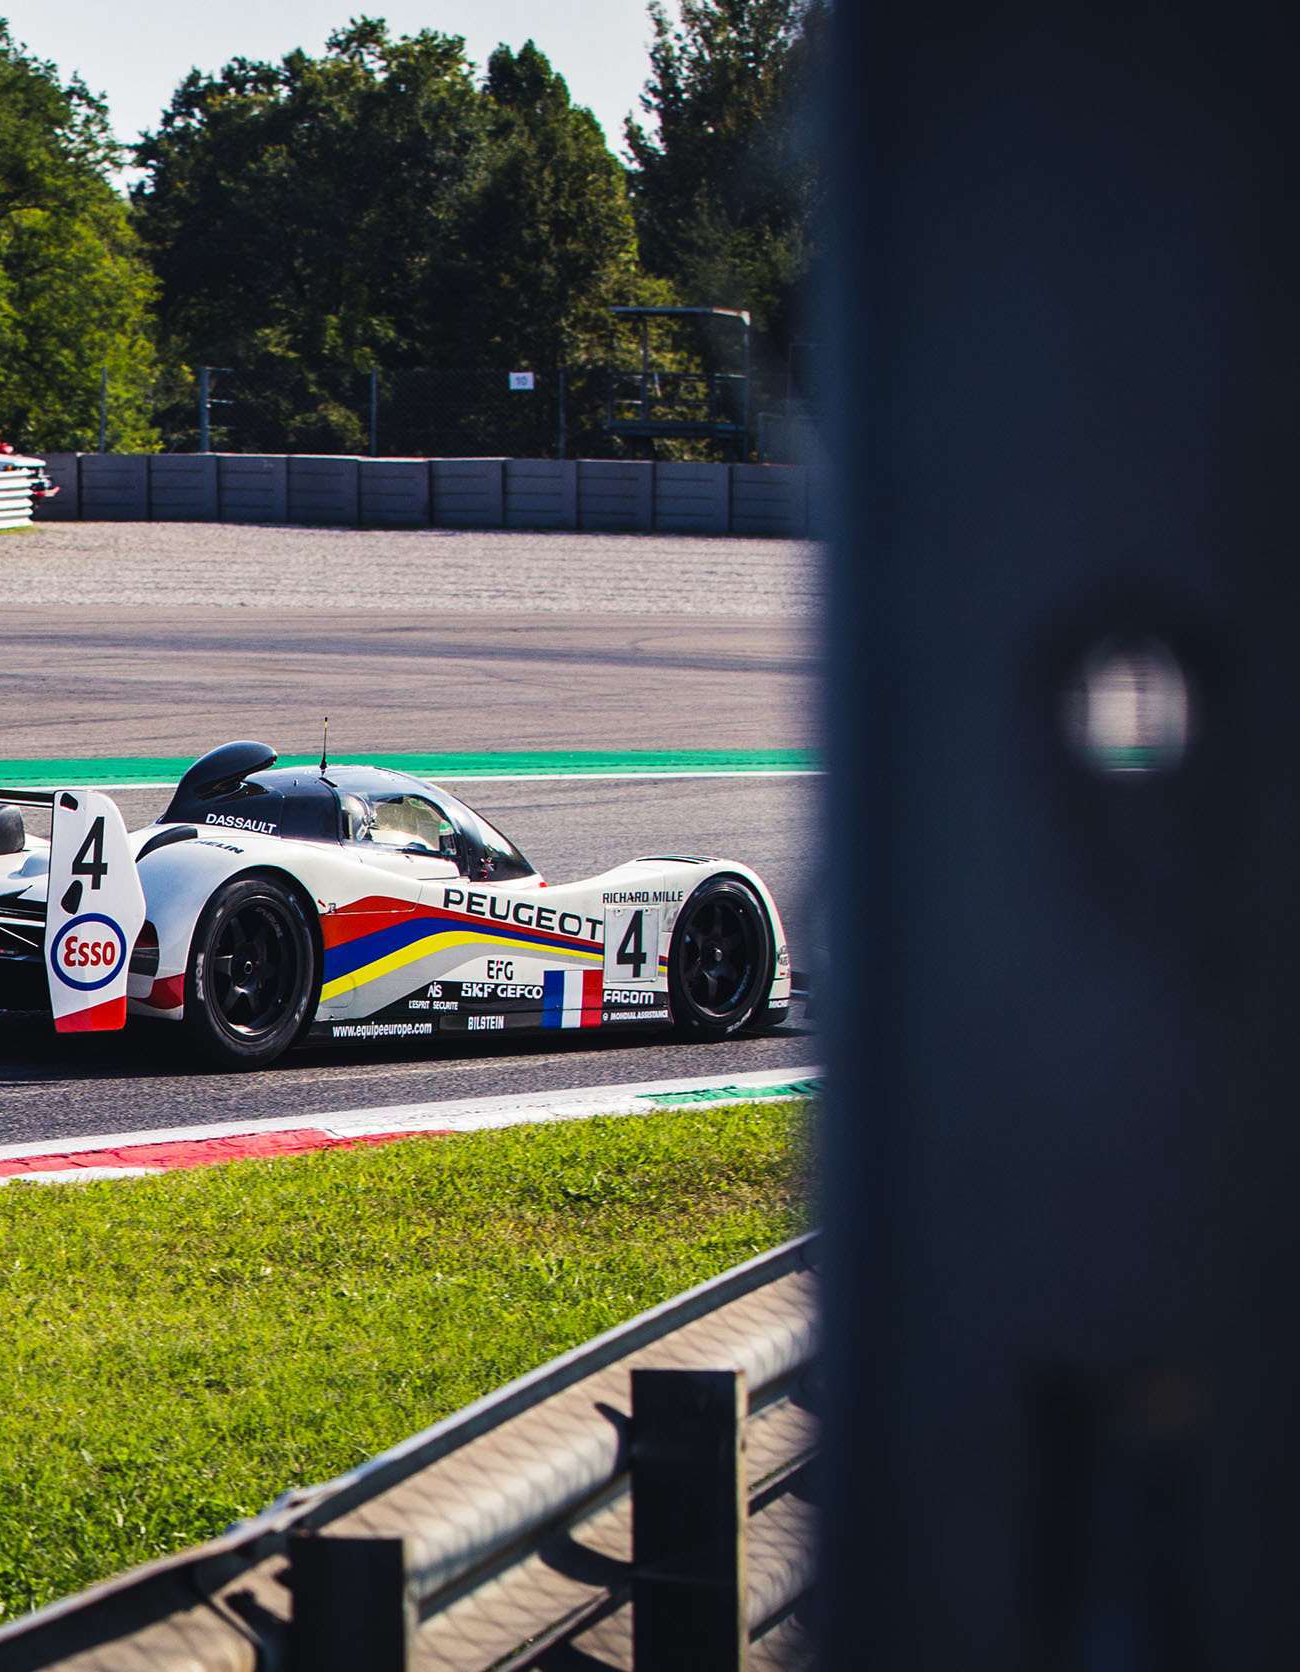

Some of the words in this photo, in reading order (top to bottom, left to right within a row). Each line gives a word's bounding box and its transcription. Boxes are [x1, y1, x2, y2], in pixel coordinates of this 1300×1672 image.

[205, 813, 277, 834] DASSAULT
[71, 816, 108, 890] 4
[602, 891, 650, 904] RICHARD
[652, 890, 684, 903] MILLE
[443, 888, 604, 940] PEUGEOT
[616, 909, 647, 978] 4
[487, 959, 514, 981] EFG
[460, 982, 494, 999] SKF
[497, 984, 544, 1000] GEFCO
[603, 990, 654, 1005] FACOM
[332, 1021, 432, 1039] www.equipeeurope.com
[467, 1016, 505, 1031] BILSTEIN
